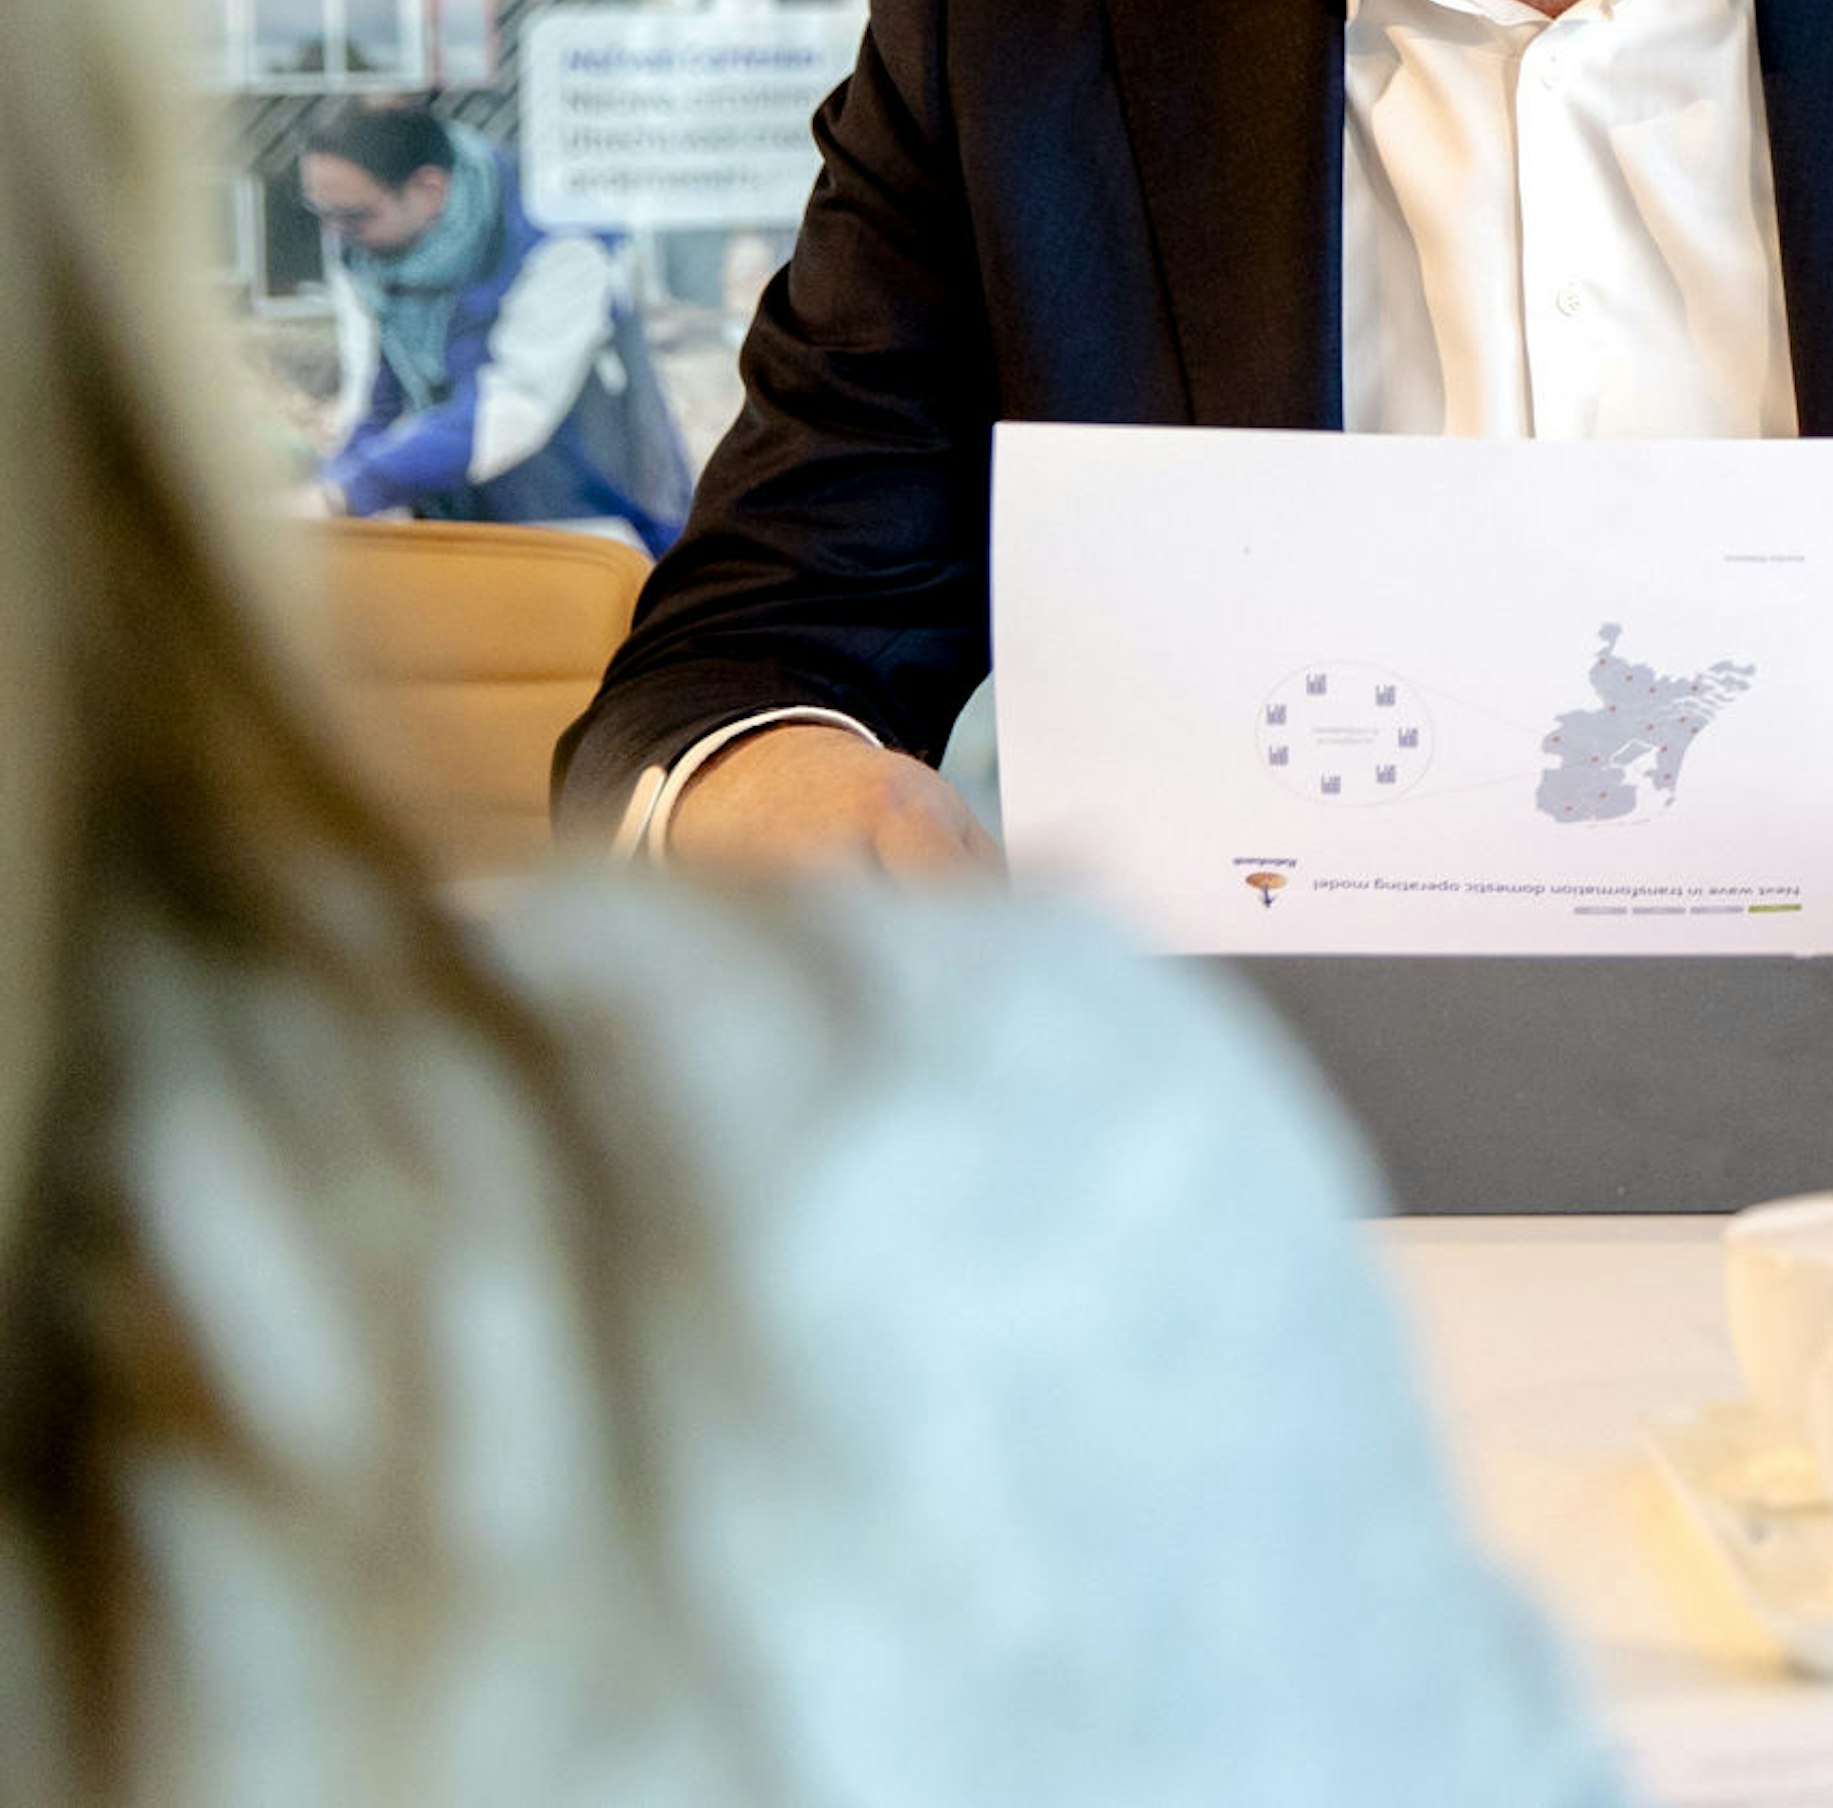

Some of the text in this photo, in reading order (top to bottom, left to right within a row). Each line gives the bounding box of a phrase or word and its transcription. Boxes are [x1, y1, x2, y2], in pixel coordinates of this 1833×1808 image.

[1313, 878, 1370, 892] model
[1373, 876, 1460, 892] operating
[1464, 881, 1547, 897] domestic
[1550, 882, 1685, 899] transformation
